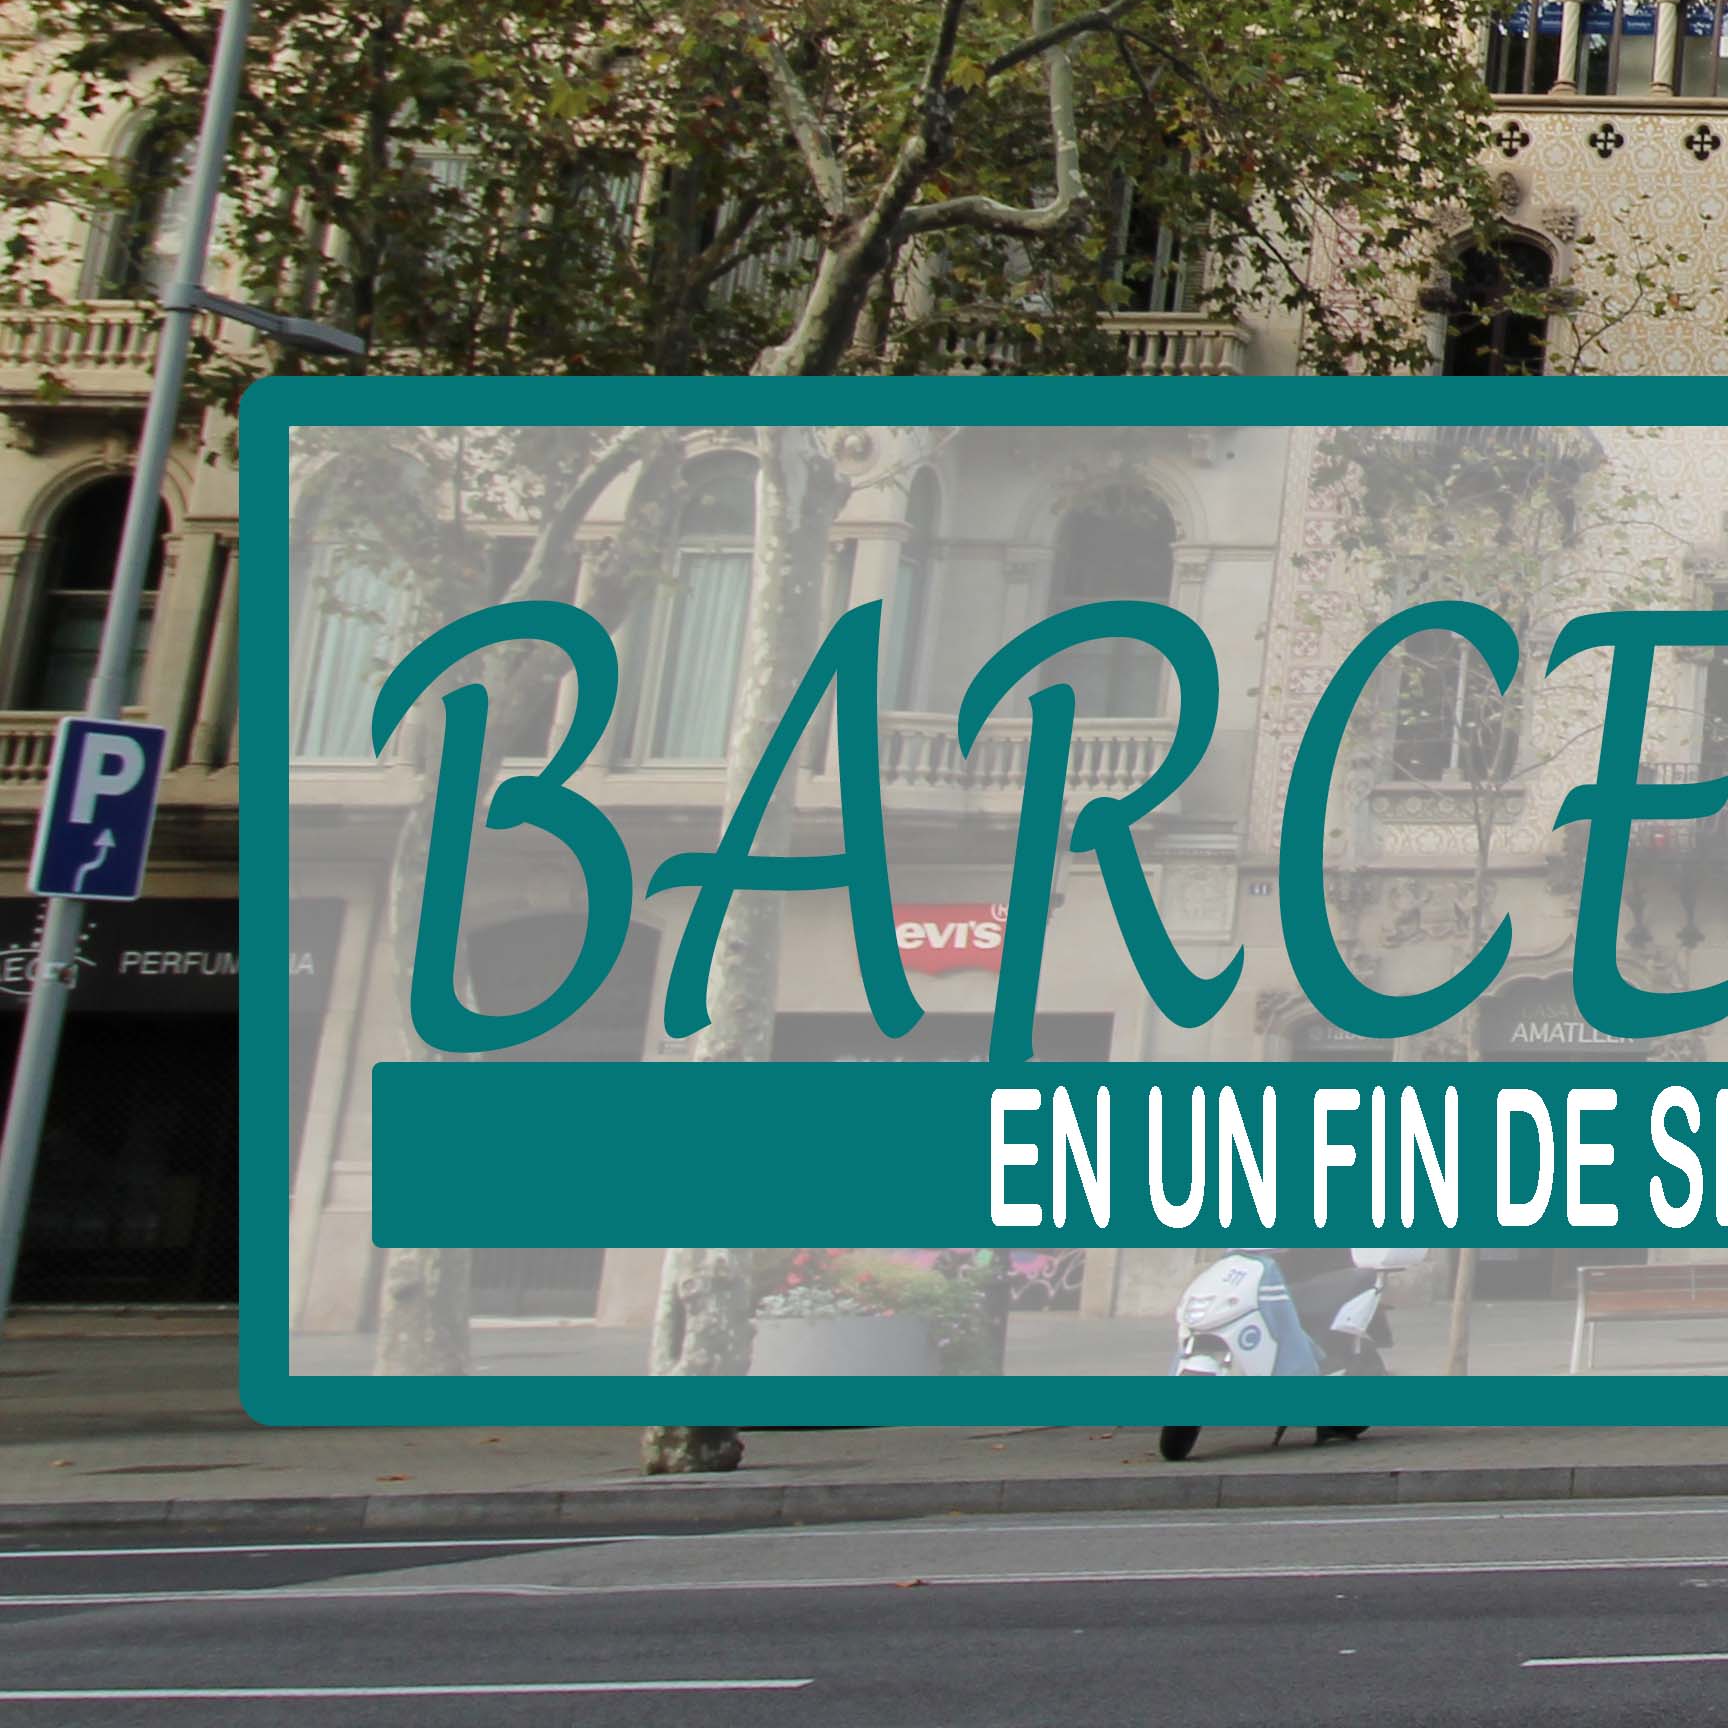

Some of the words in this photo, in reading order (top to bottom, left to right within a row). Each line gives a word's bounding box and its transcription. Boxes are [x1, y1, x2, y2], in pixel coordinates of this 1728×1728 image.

[69, 732, 146, 824] P
[895, 919, 1003, 950] evi's
[1510, 1021, 1635, 1043] AMATLL
